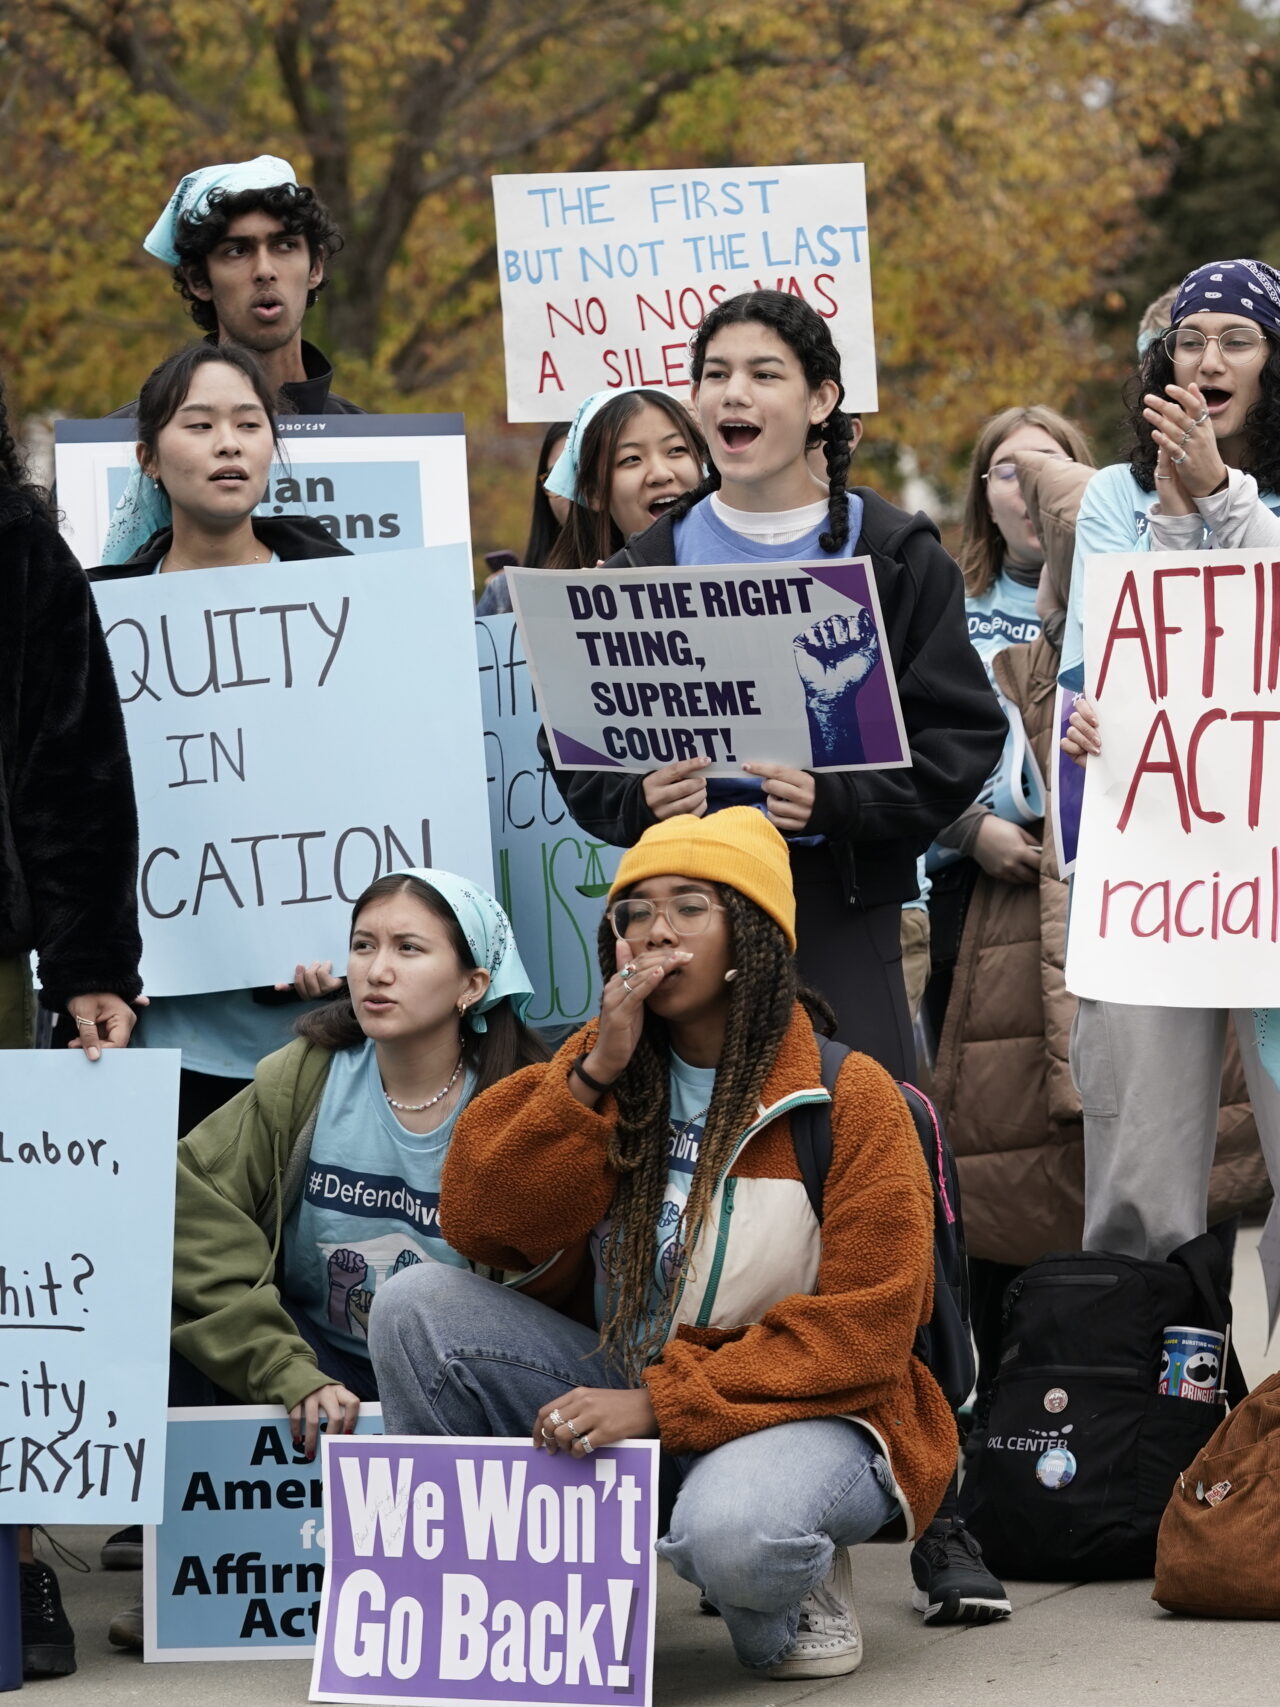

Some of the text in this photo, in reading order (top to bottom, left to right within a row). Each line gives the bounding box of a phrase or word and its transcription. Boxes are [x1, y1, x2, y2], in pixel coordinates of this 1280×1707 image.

[527, 179, 779, 227] THE FIRST
[504, 225, 866, 284] BUT NOT THE LAST
[546, 297, 607, 338] NO
[637, 284, 727, 331] NOS
[539, 351, 565, 394] A
[567, 577, 814, 620] DO THE RIGHT
[105, 596, 350, 703] QUITY
[576, 630, 706, 671] THING,
[590, 680, 762, 717] SUPREME
[166, 728, 246, 789] IN
[602, 725, 737, 762] COURT!
[1098, 846, 1280, 944] racial
[338, 1456, 445, 1561] We
[455, 1458, 642, 1565] Won't
[333, 1568, 635, 1688] Go Back!
